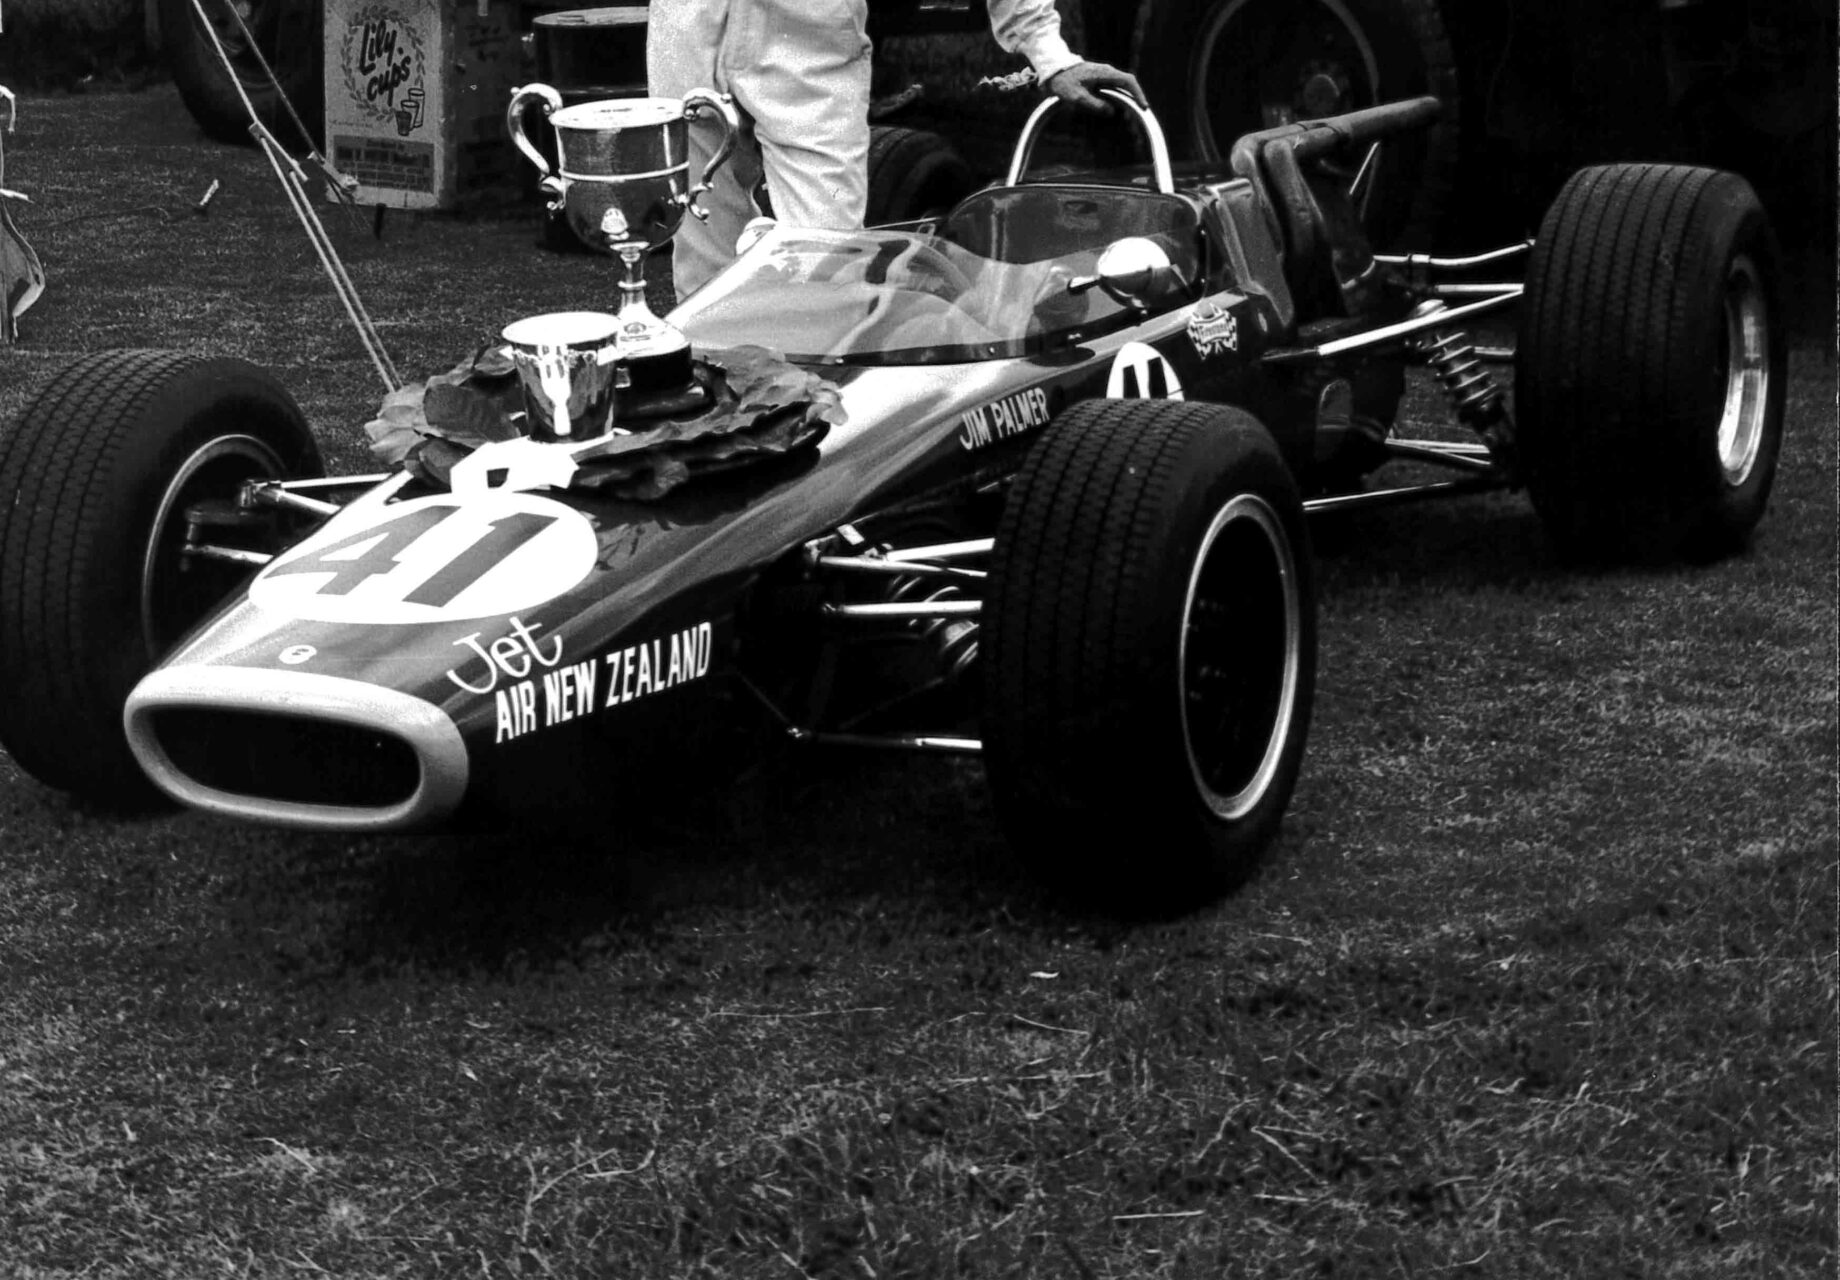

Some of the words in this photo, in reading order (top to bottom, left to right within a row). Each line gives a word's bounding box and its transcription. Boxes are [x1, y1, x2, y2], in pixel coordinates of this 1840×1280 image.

[366, 55, 411, 107] cups
[959, 405, 992, 450] JIM
[990, 387, 1050, 439] PALMER
[262, 505, 560, 608] 41
[446, 616, 563, 694] Jet
[495, 680, 536, 744] AIR
[543, 658, 597, 727] NEW
[605, 621, 712, 708] ZEALAND
